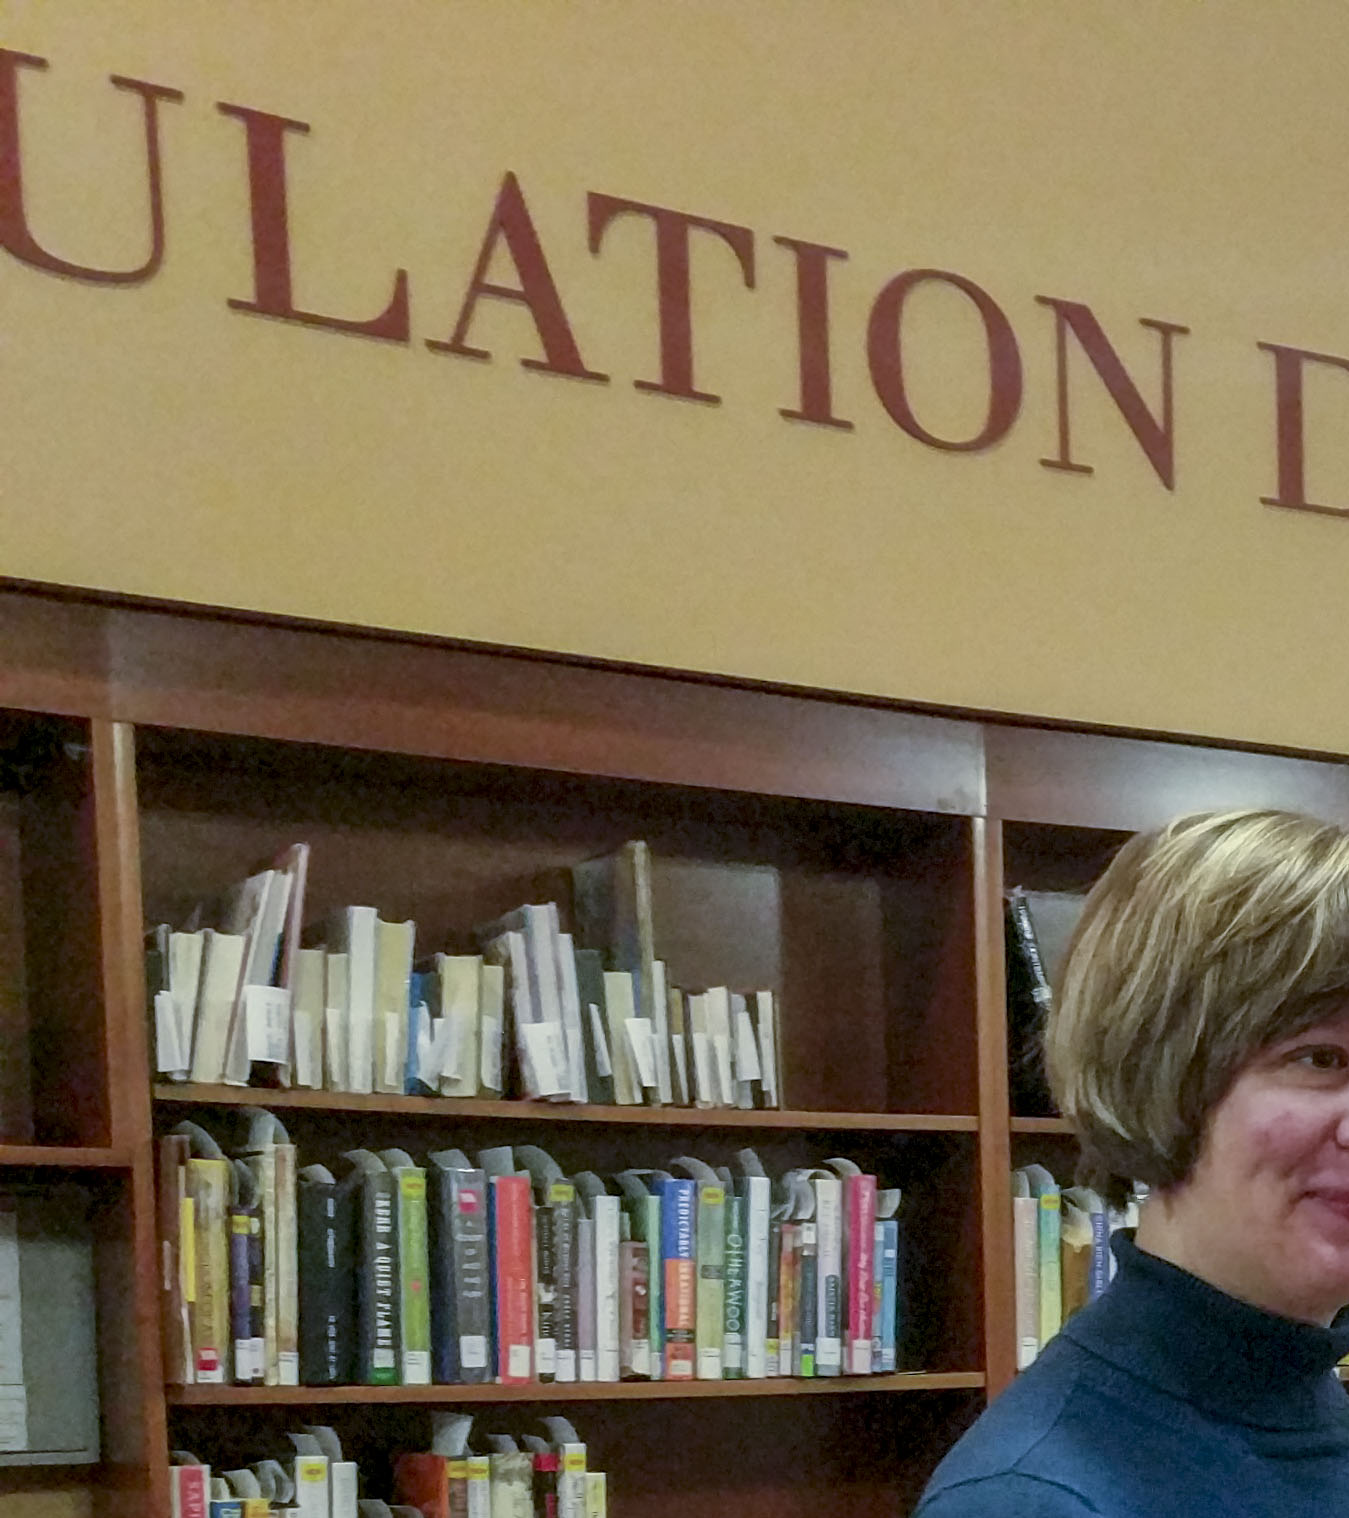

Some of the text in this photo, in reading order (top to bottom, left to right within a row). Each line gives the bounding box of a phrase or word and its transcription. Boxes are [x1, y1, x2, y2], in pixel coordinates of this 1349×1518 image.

[0, 47, 1192, 492] ULATION
[678, 1189, 691, 1258] PREDICTABLY
[375, 1256, 392, 1296] QUIET
